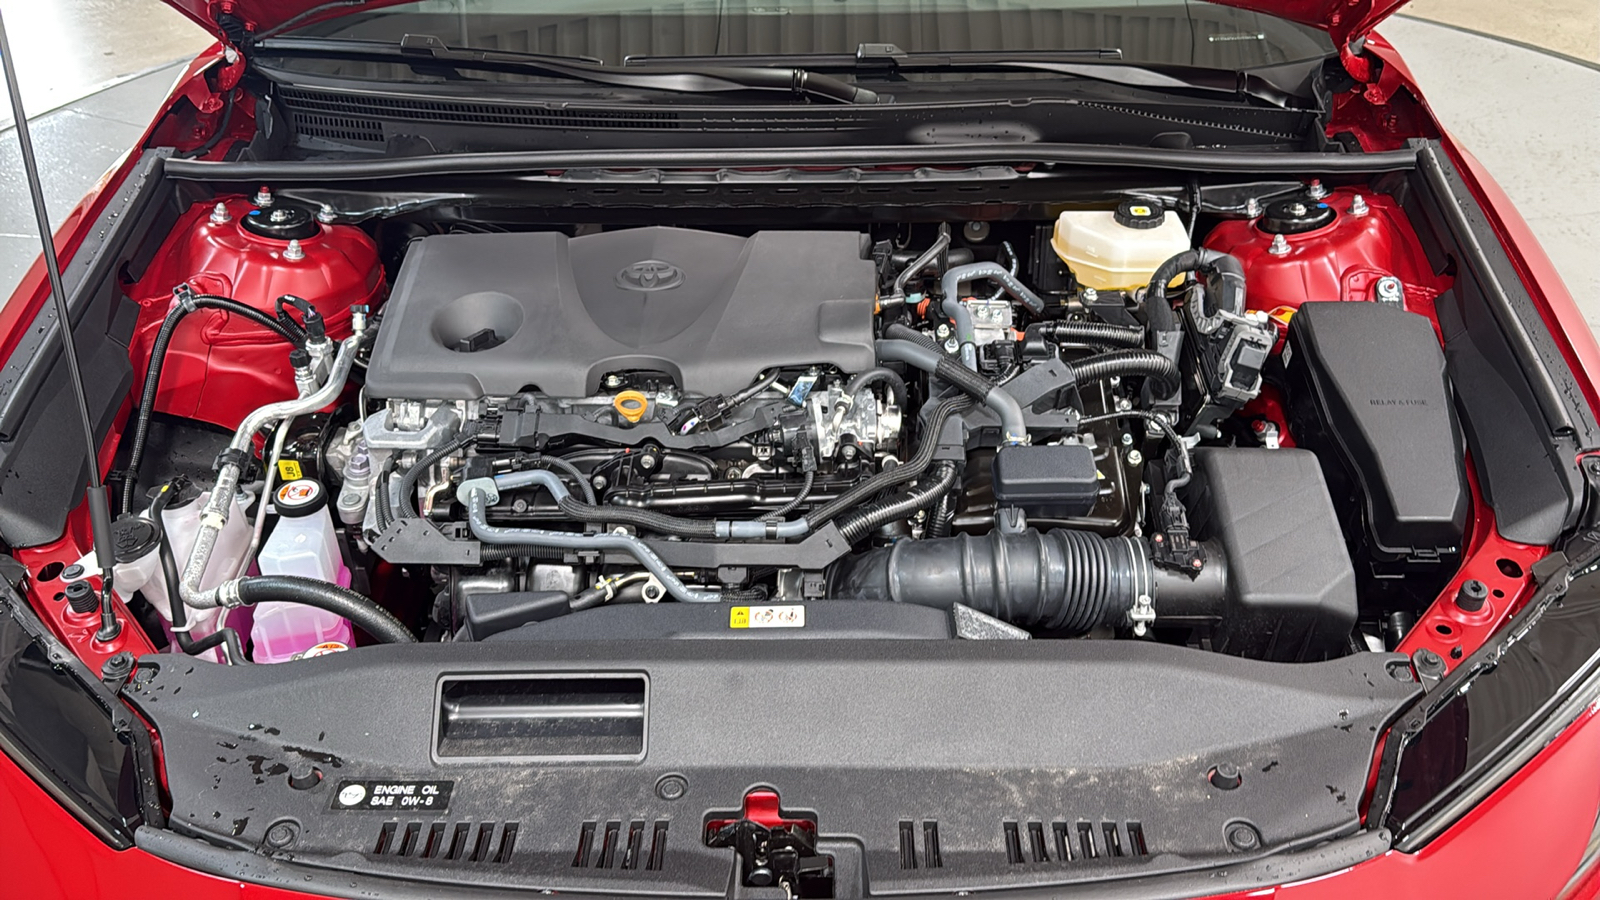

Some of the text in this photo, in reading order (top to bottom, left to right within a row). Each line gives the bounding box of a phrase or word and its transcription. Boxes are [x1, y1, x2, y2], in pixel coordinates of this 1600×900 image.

[1369, 399, 1397, 407] RELAY
[1406, 399, 1429, 407] FUSE
[373, 785, 440, 795] ENGINE OIL
[370, 796, 395, 806] SAE
